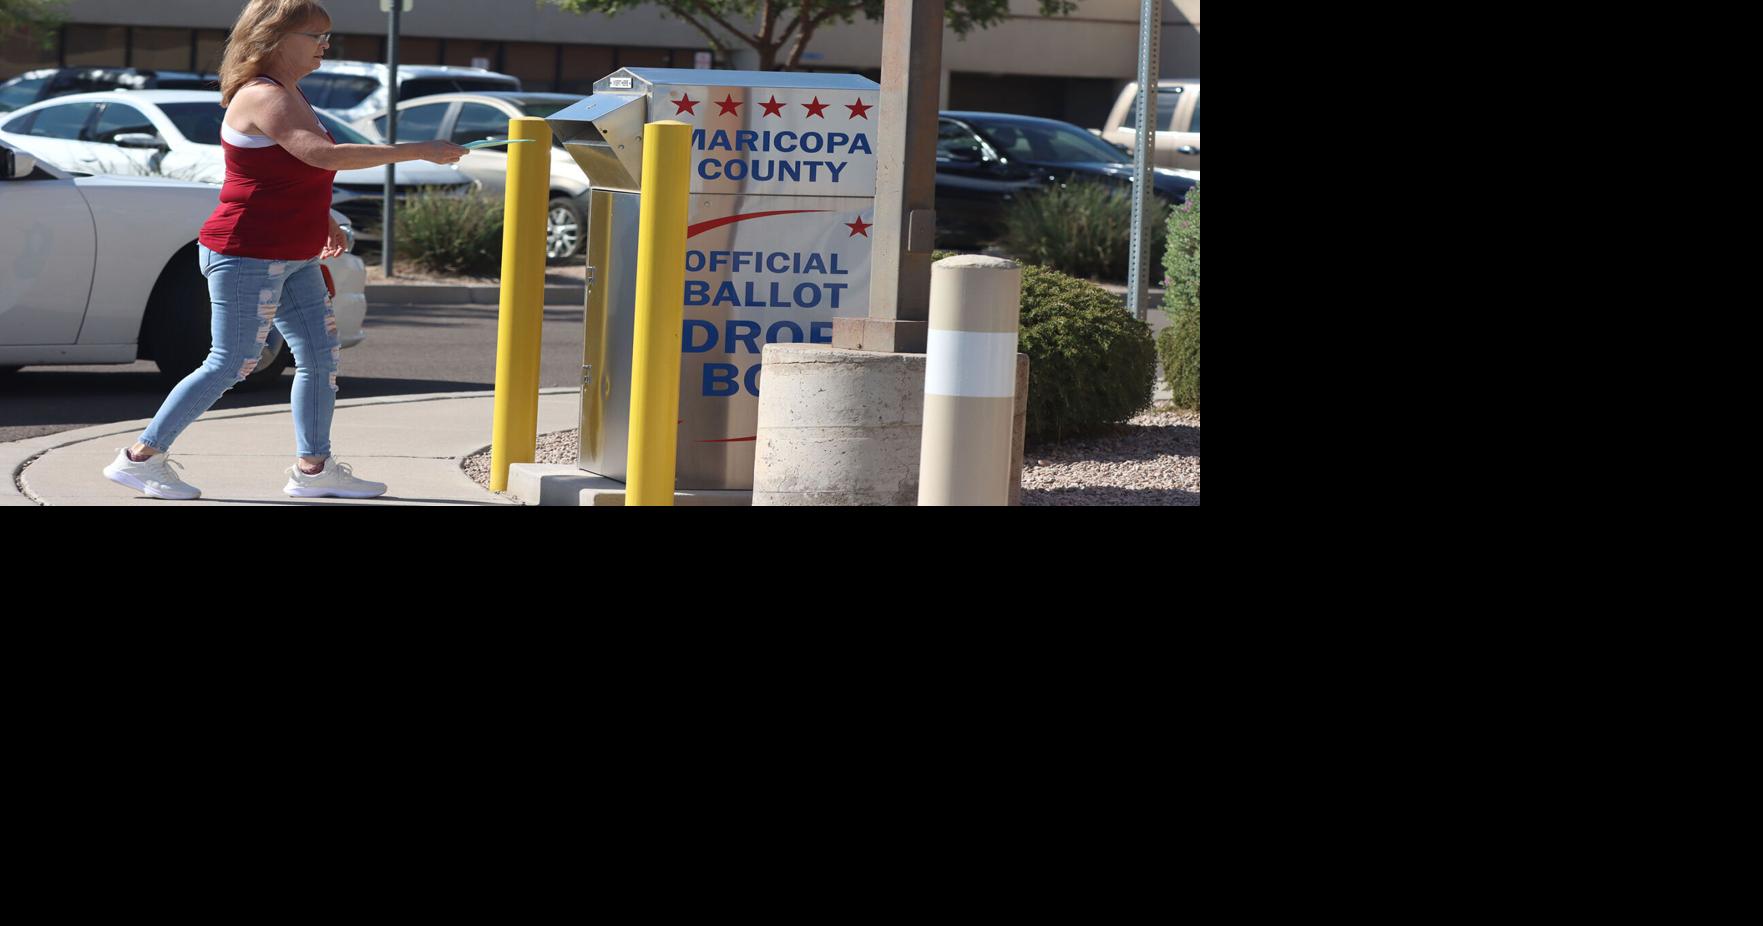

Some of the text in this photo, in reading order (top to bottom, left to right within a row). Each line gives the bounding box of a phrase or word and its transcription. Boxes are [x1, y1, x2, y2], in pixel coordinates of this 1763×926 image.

[698, 158, 848, 183] COUNTY
[685, 250, 848, 274] OFFICIAL
[683, 280, 848, 308] BALLOT
